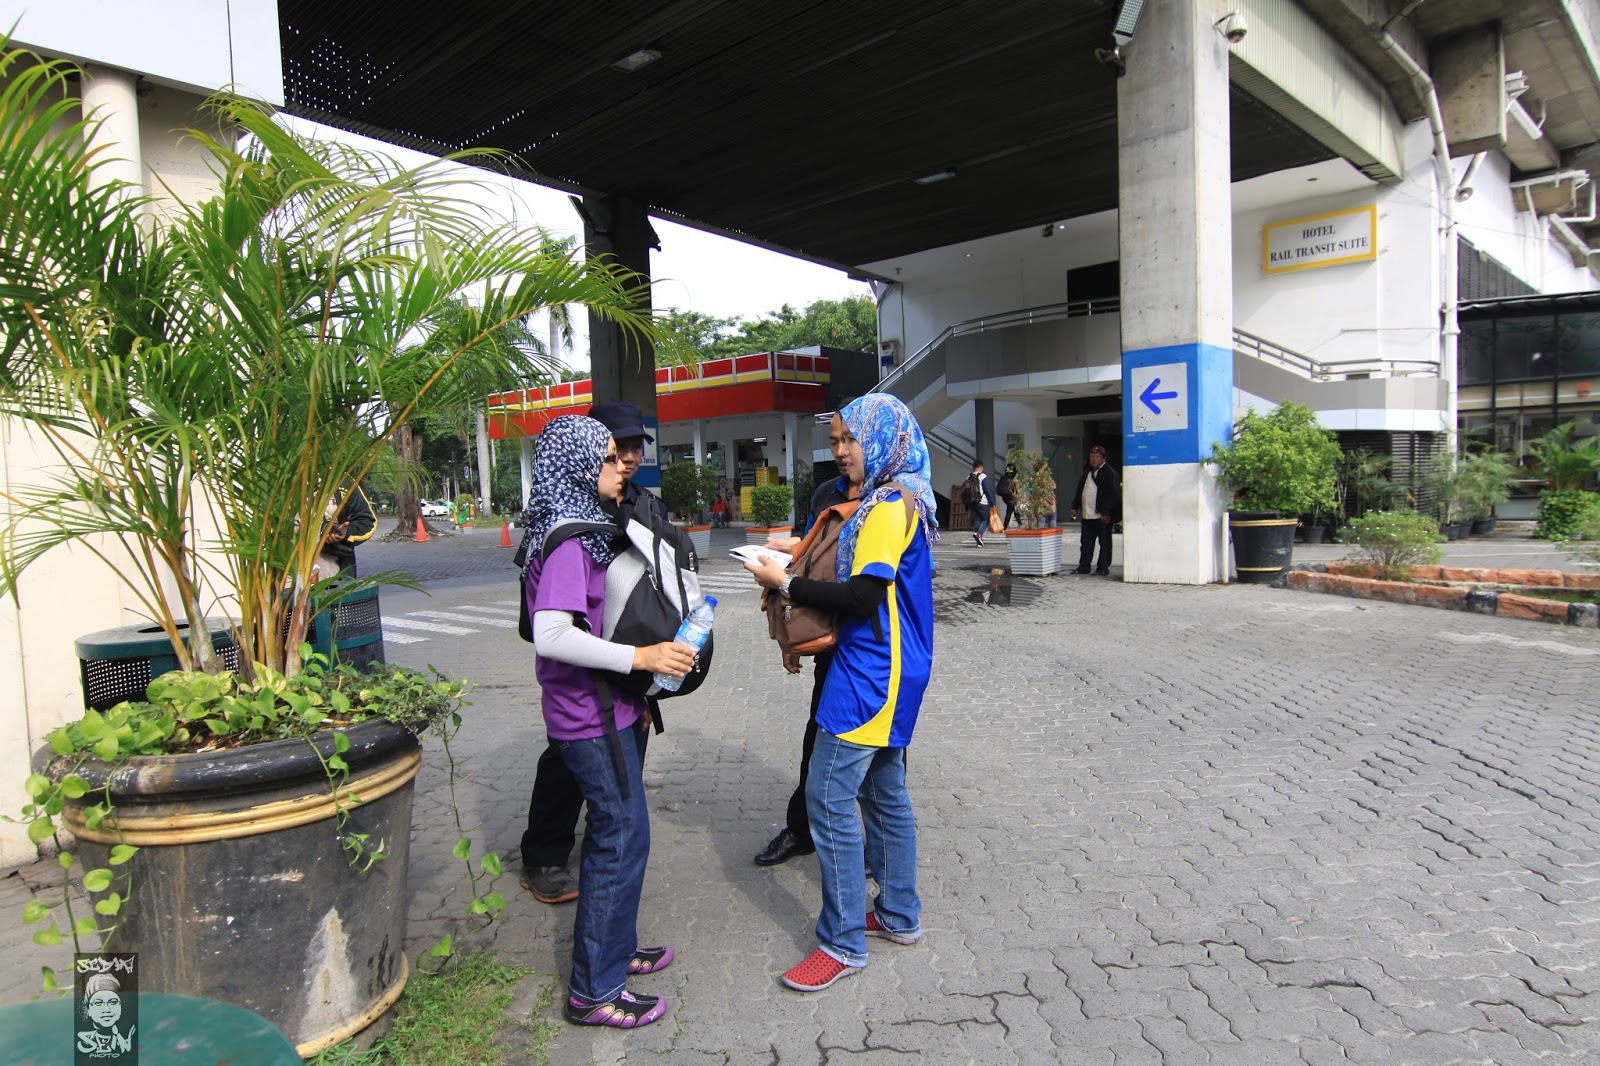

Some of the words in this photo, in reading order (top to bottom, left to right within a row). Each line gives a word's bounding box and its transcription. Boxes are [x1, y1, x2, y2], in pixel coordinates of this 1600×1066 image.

[1302, 225, 1335, 239] HOTEL
[1270, 250, 1293, 262] RAIL
[1295, 243, 1336, 257] TRANSIT
[1338, 237, 1368, 250] SUITE
